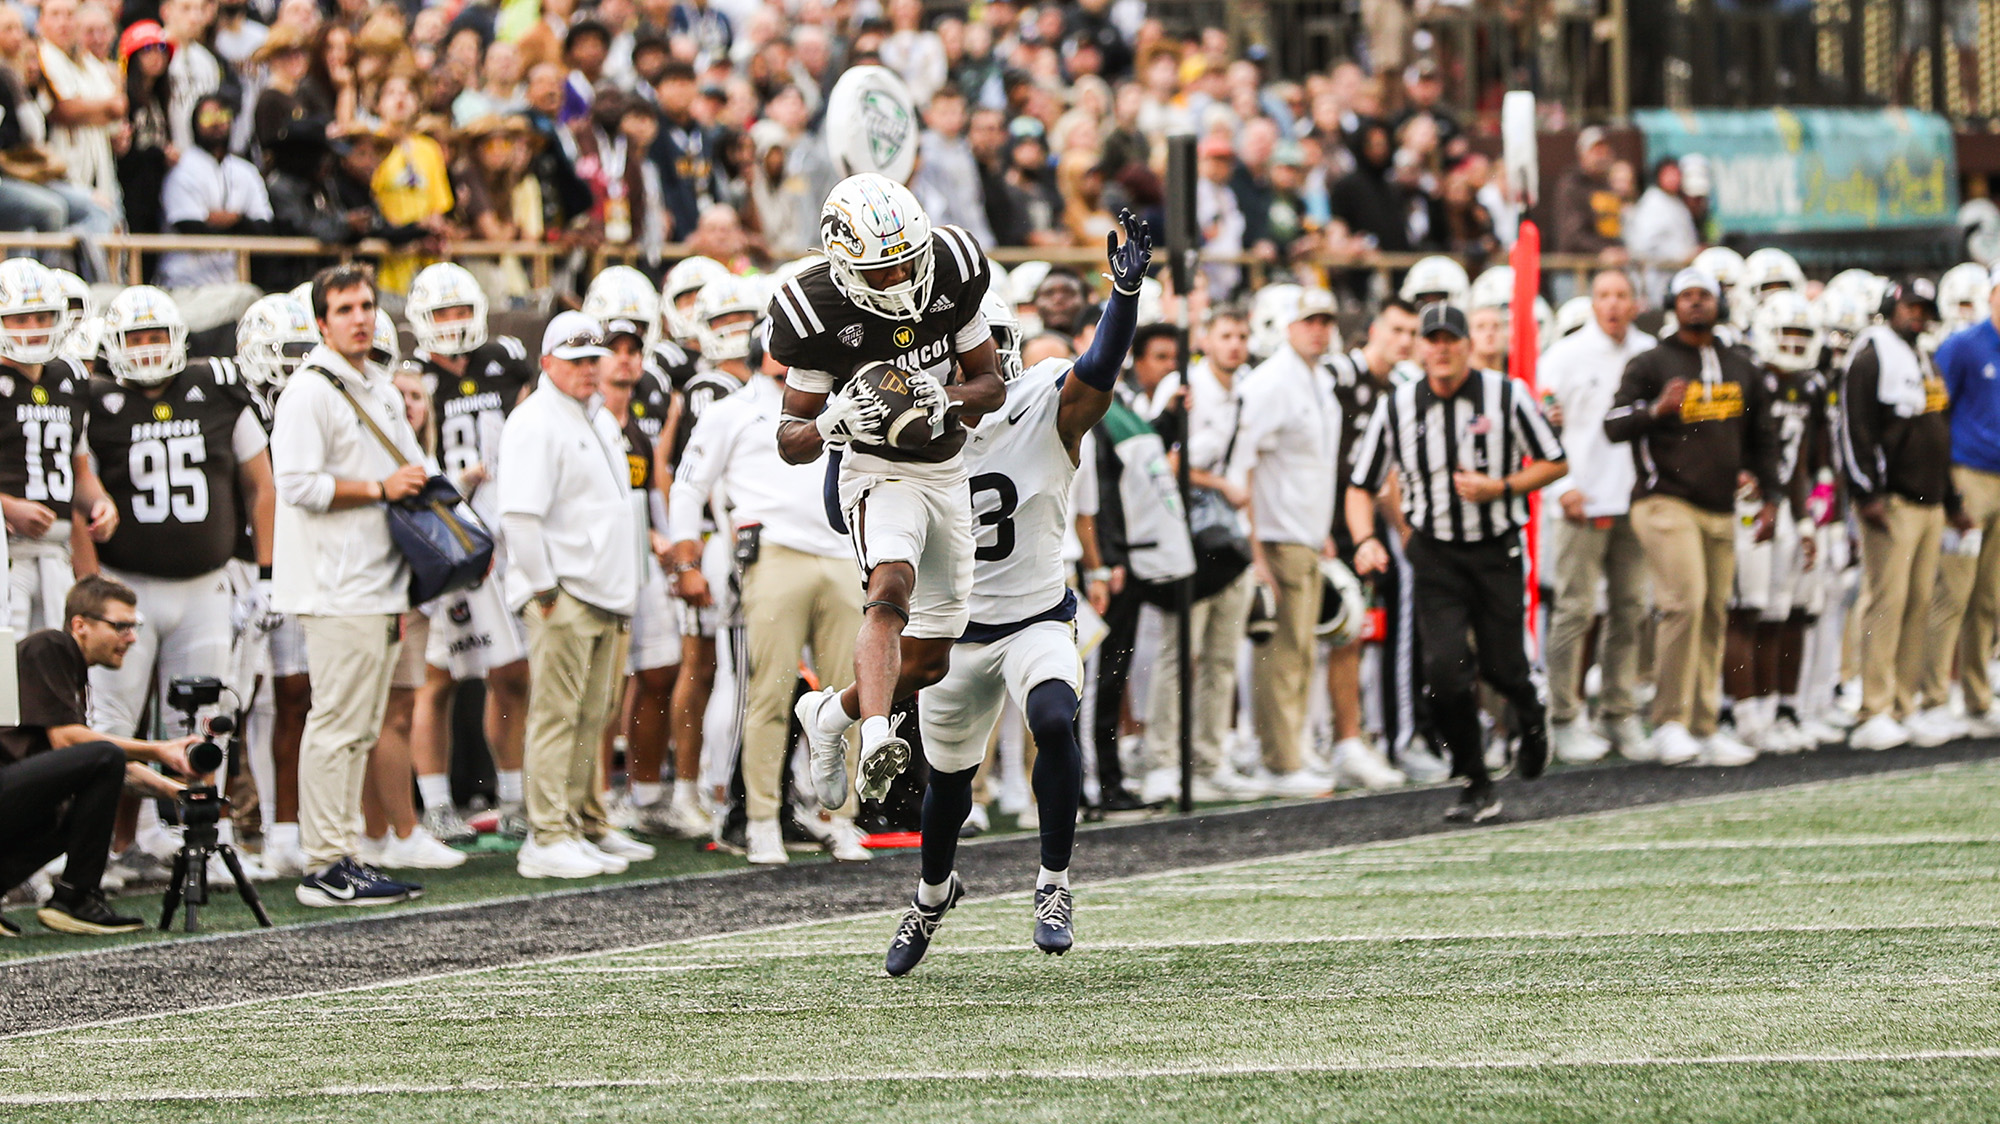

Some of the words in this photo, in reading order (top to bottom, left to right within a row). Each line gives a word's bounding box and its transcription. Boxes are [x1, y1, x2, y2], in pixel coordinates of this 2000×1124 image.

[886, 243, 906, 256] EAT
[929, 302, 955, 313] adidas
[896, 330, 911, 345] W
[885, 333, 950, 371] ONCOS
[16, 404, 71, 422] BRONCOS
[131, 419, 201, 442] BRONCOS
[22, 420, 73, 502] 13
[128, 434, 209, 523] 95
[968, 472, 1019, 562] 3
